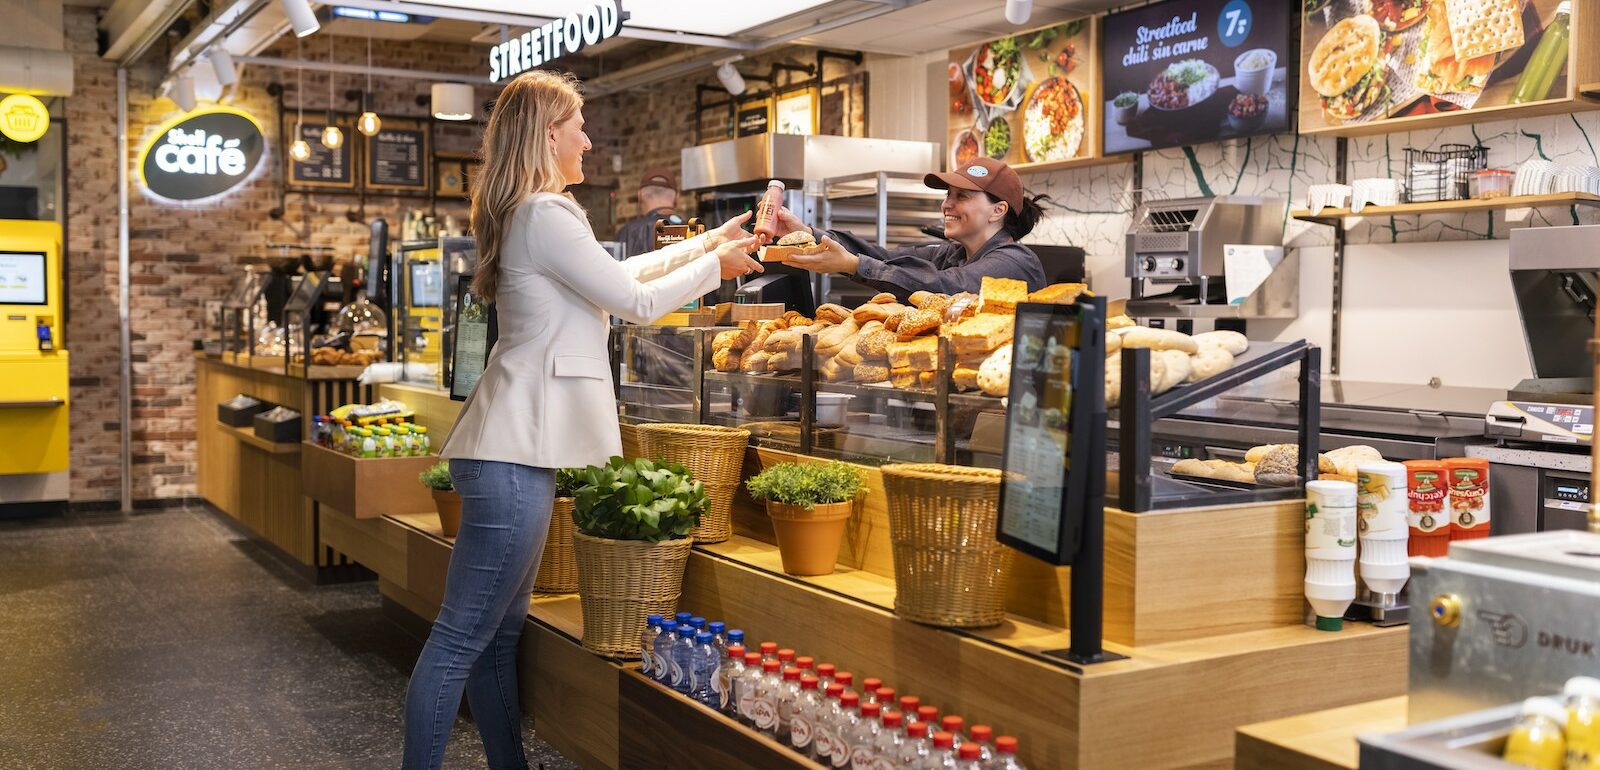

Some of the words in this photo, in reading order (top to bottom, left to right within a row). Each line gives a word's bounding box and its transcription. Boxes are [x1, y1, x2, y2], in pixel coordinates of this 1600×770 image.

[489, 0, 618, 83] STREETFOOD
[1136, 12, 1197, 44] Streetfood
[1122, 44, 1149, 66] chili
[1152, 41, 1171, 60] sin
[1173, 37, 1208, 56] carne
[167, 128, 206, 146] Shell
[155, 134, 246, 176] café
[1408, 489, 1444, 501] Ketchup
[1537, 631, 1596, 656] DRUK
